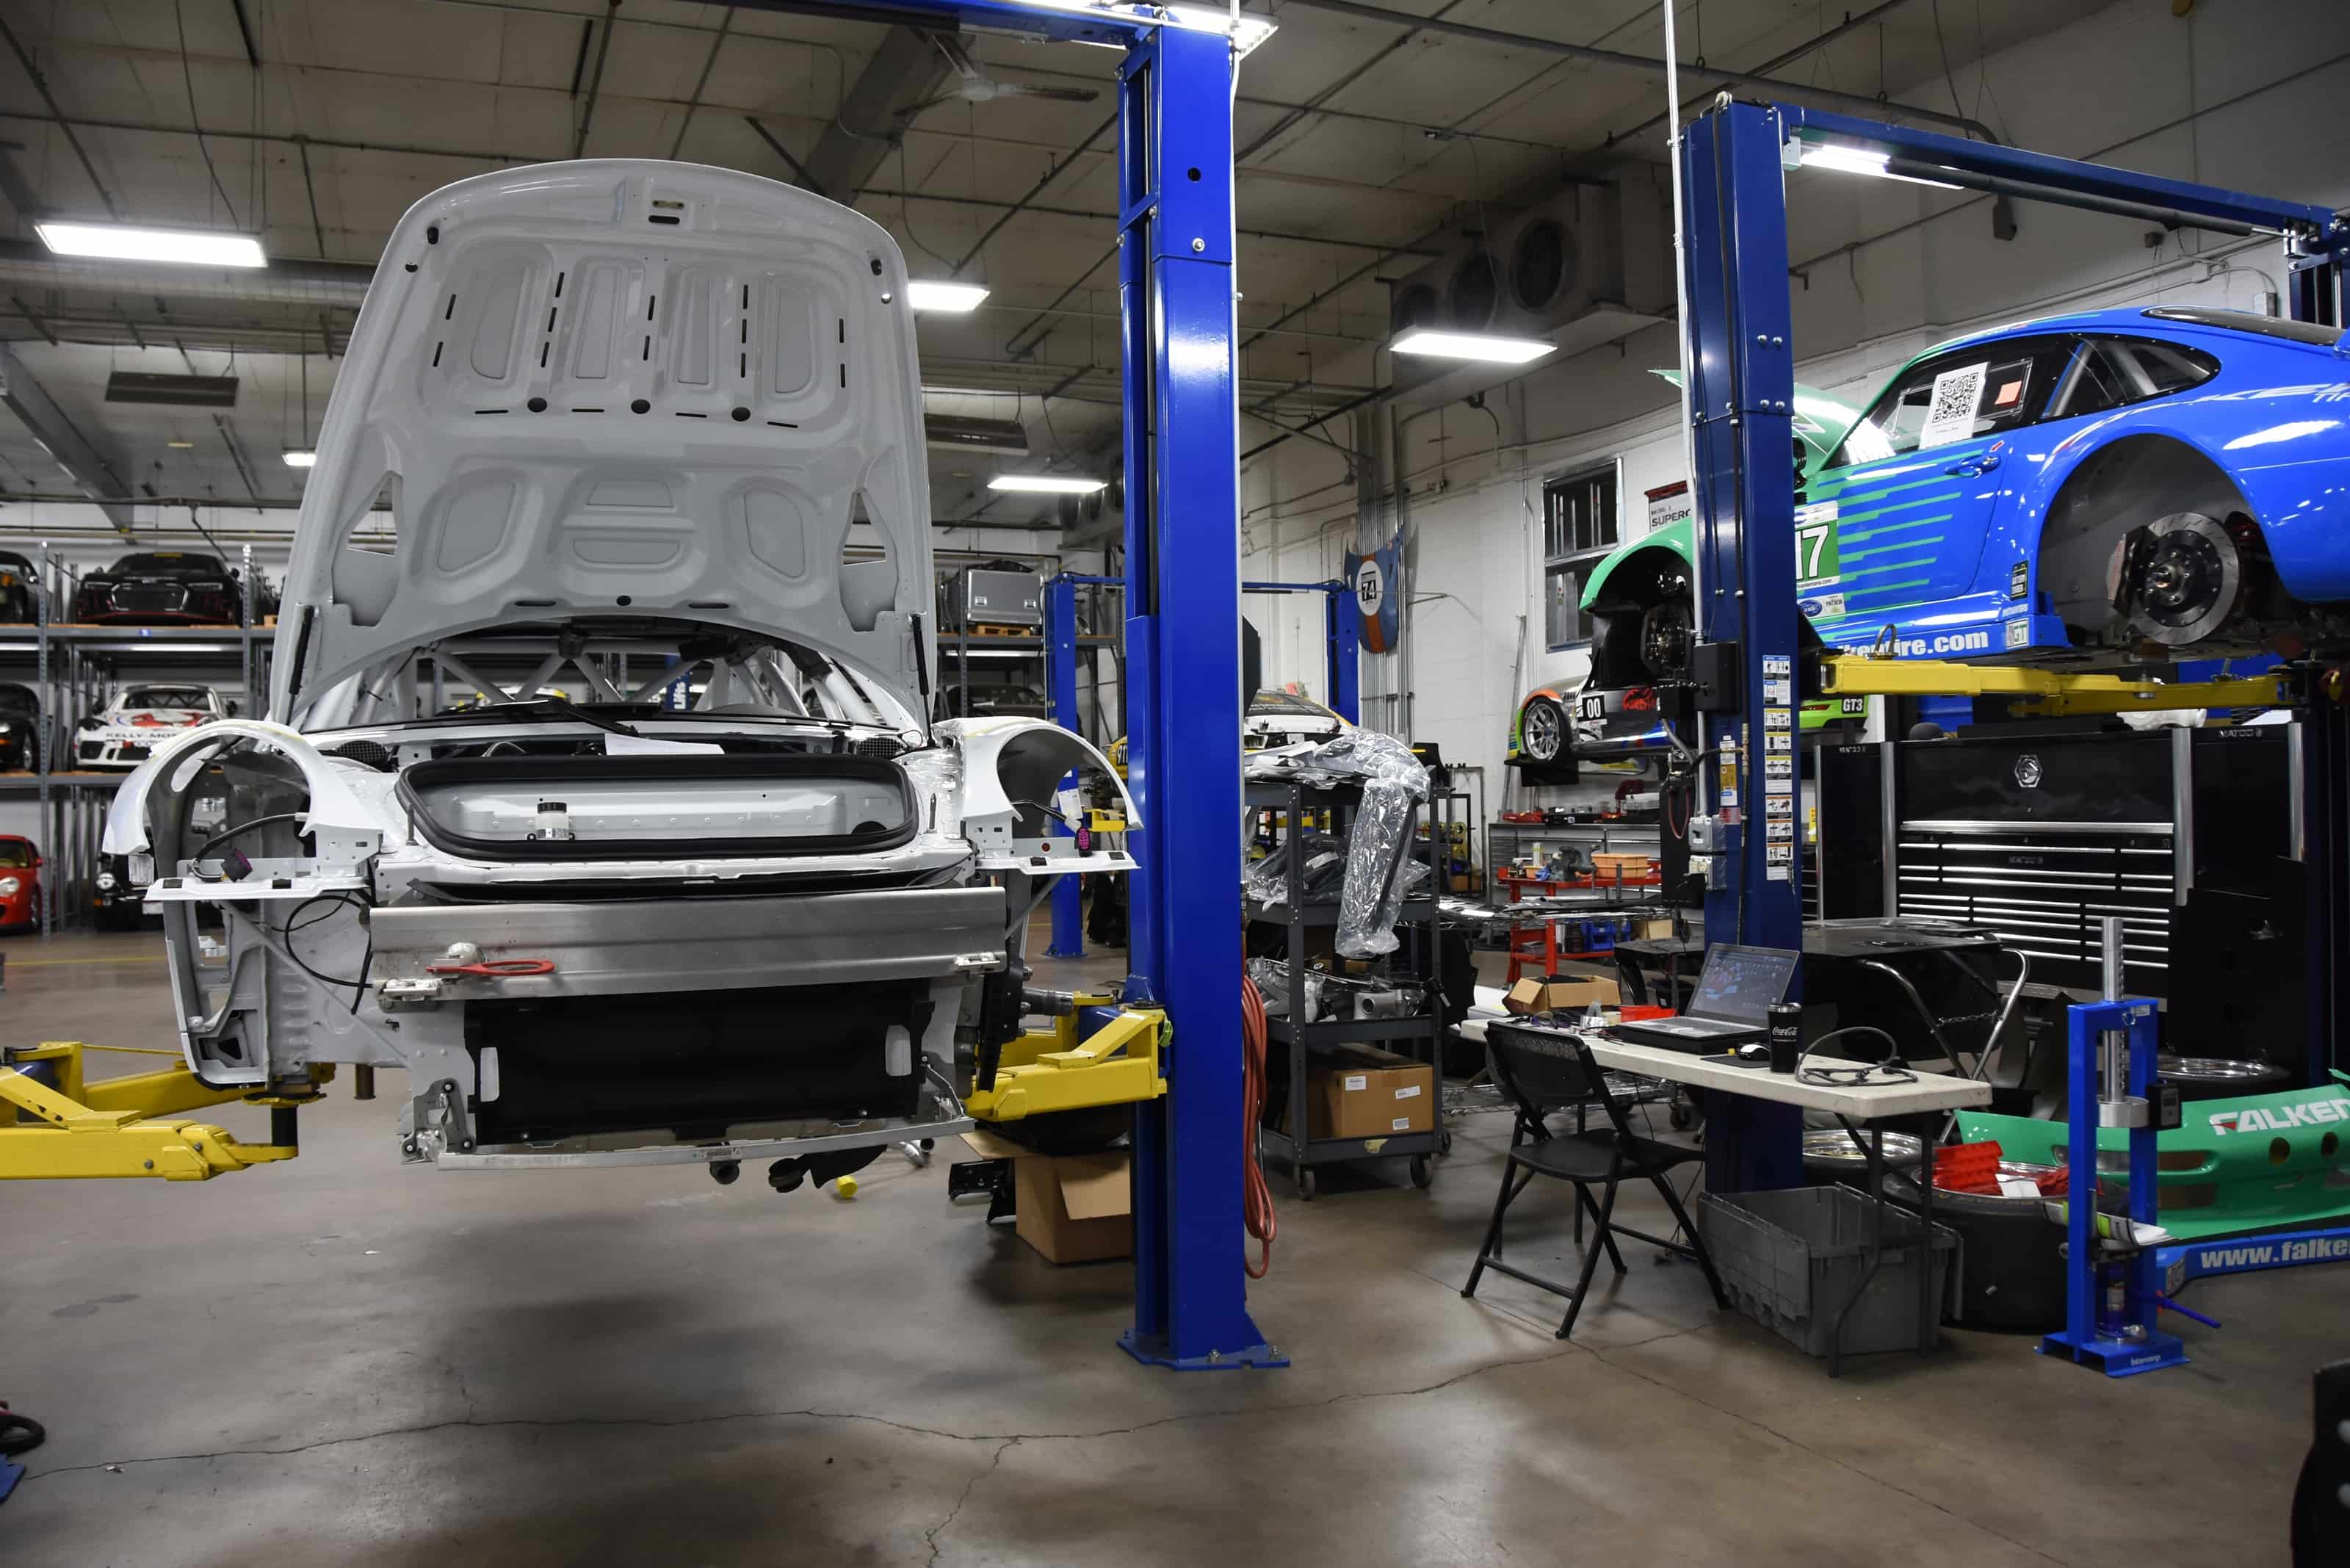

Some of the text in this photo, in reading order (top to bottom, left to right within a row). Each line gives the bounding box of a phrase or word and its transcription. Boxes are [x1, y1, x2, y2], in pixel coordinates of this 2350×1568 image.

[1362, 580, 1375, 600] 74
[1586, 698, 1602, 718] 00
[1843, 698, 1863, 712] GT3
[2200, 1238, 2350, 1269] www.falke
